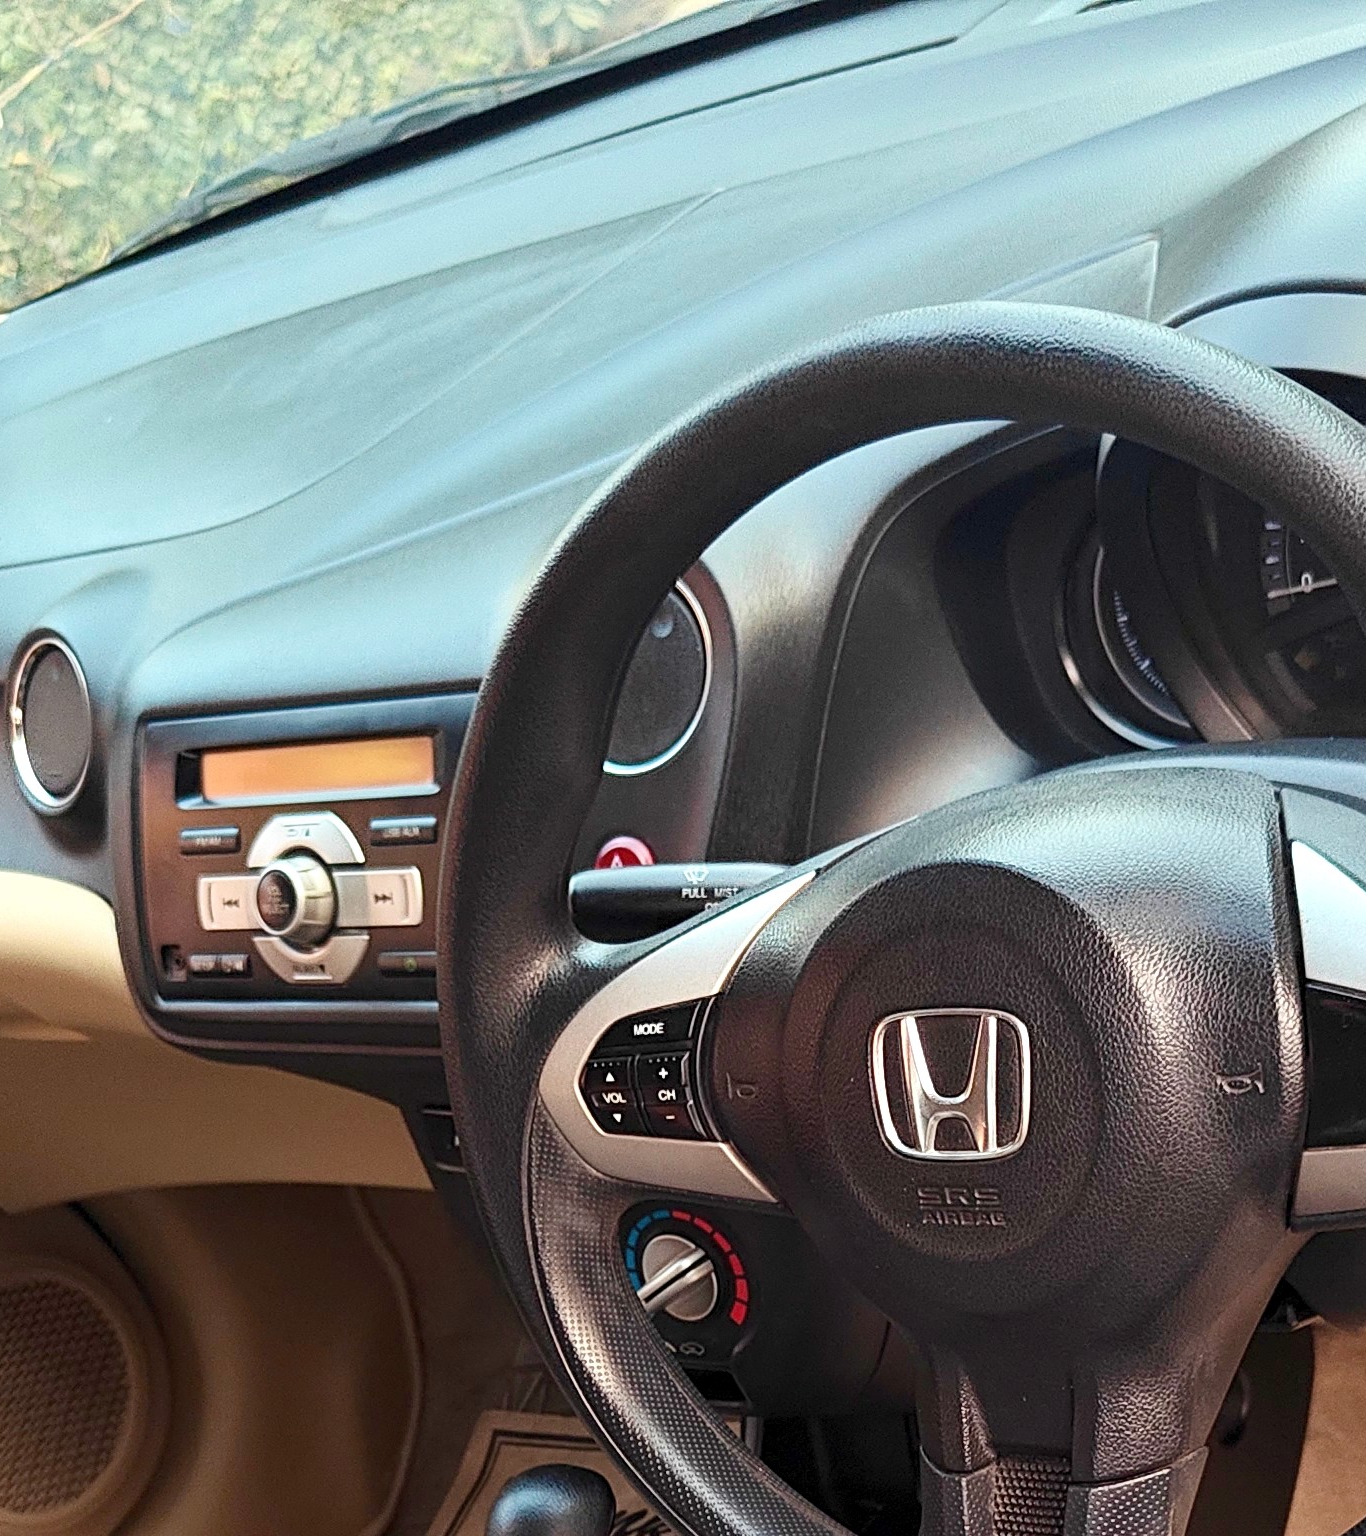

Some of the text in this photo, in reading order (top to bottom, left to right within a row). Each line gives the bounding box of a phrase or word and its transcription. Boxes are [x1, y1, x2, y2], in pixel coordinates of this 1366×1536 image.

[633, 1022, 665, 1036] MODE
[602, 1092, 627, 1104] VOL
[657, 1089, 676, 1101] CH
[917, 1187, 1000, 1205] SRS
[921, 1210, 1006, 1226] AIRBAG
